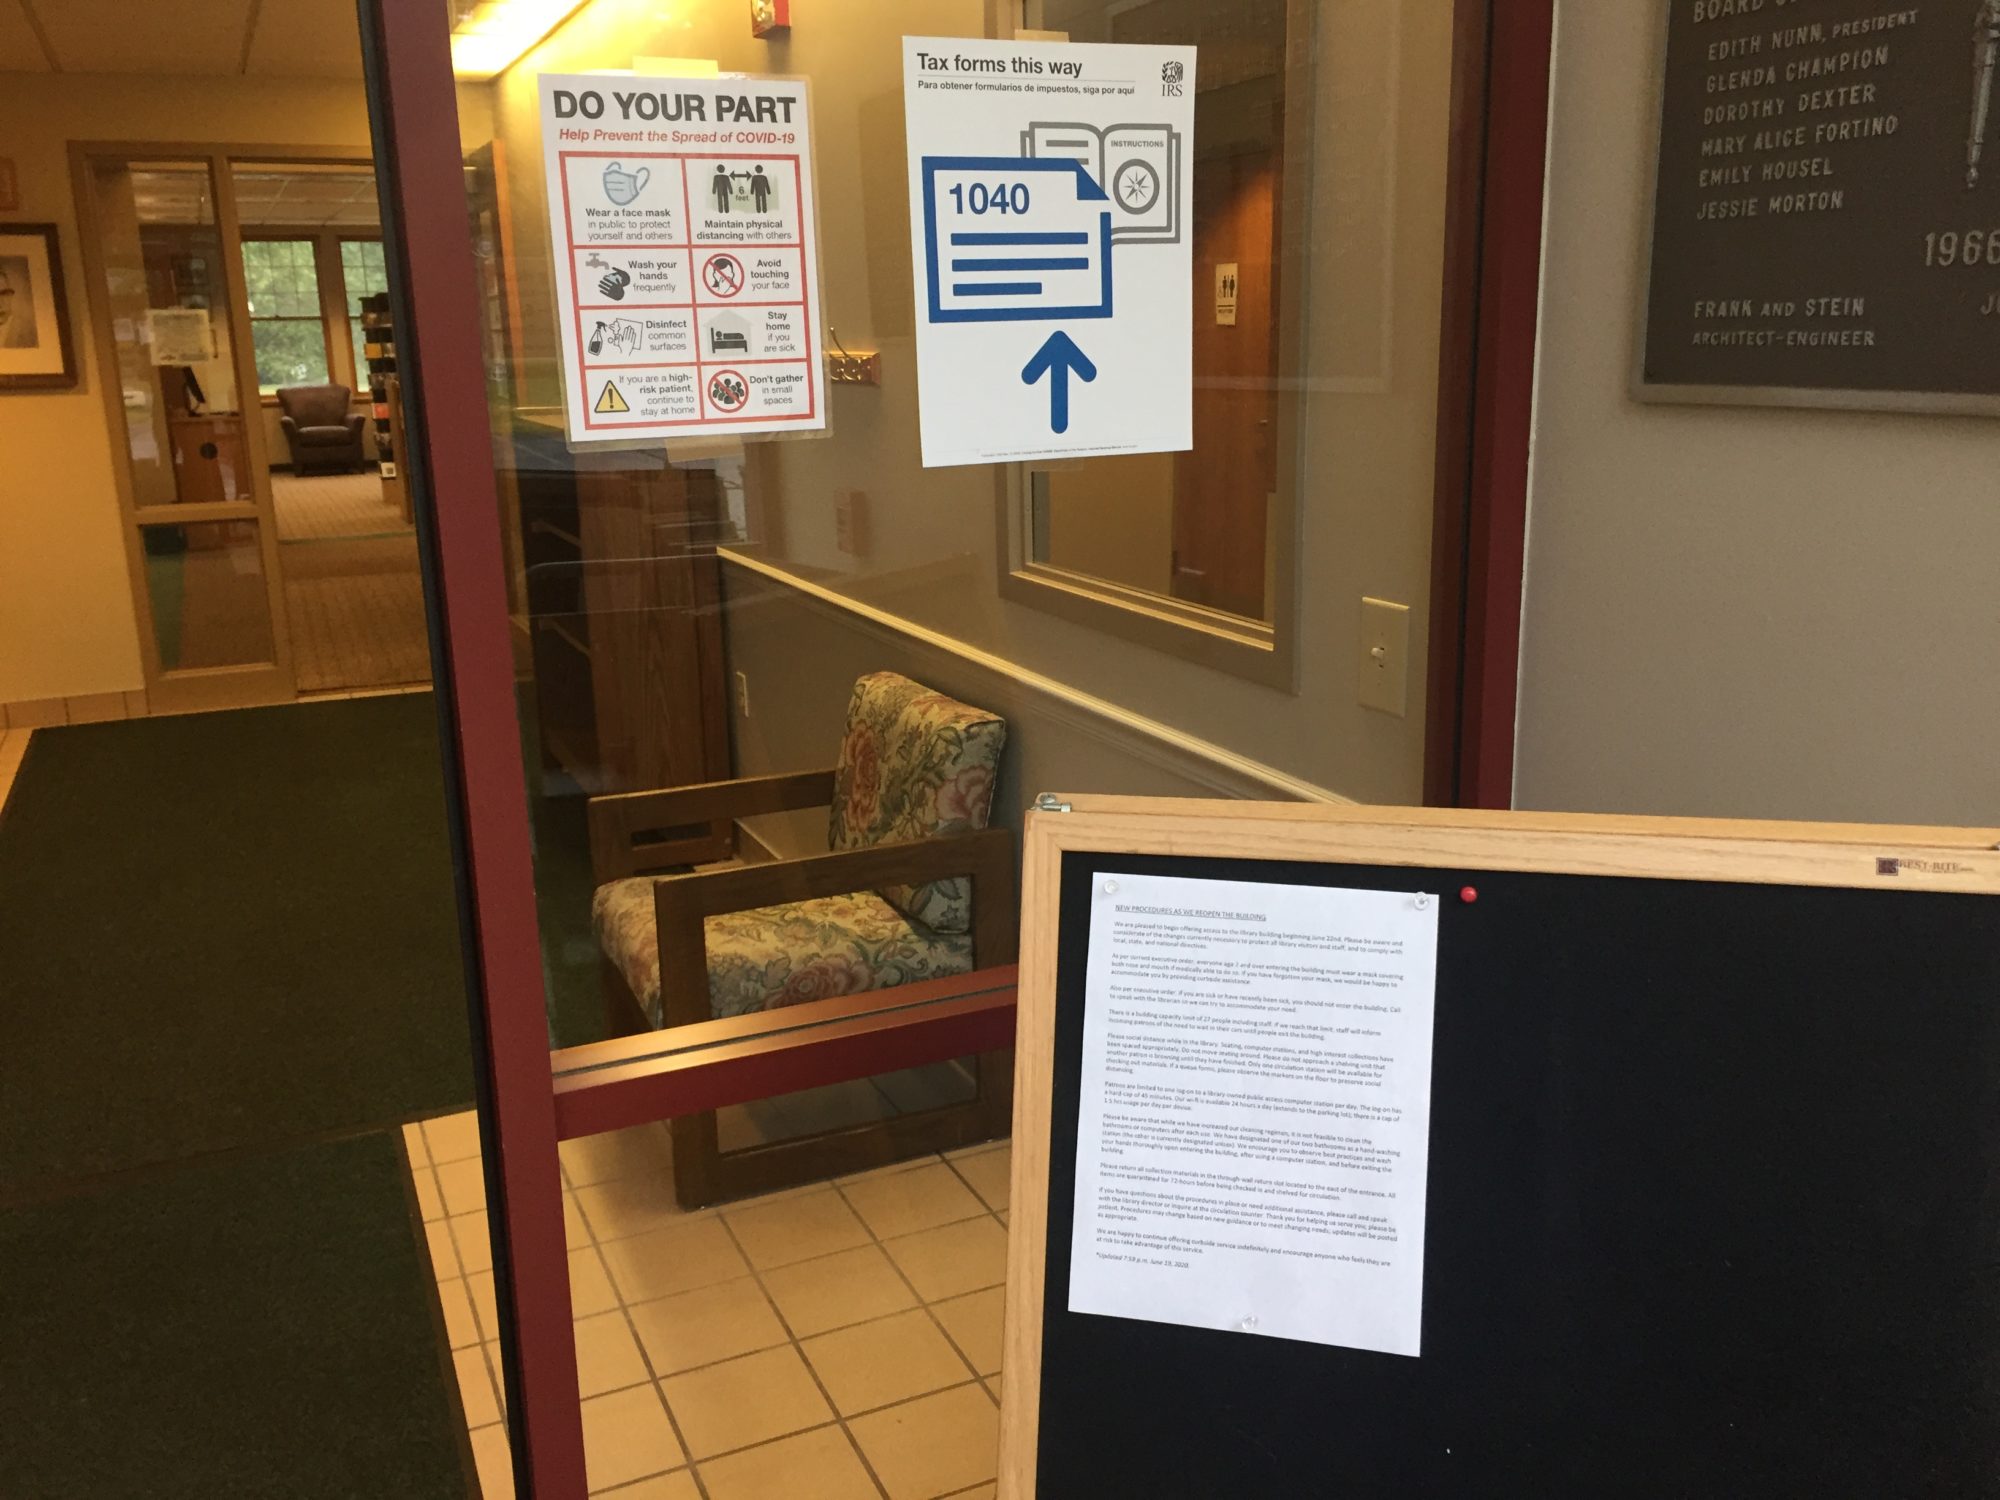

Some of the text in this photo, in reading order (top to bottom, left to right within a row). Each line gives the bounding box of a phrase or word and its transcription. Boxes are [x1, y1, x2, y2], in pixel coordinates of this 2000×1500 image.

[1694, 0, 1763, 23] BOARD
[1708, 10, 1919, 61] EDITH NUNN, PRESIDENT
[917, 53, 1082, 78] Tax forms this way
[1707, 46, 1889, 93] GLENDA CHAMPION
[918, 81, 937, 89] Para
[940, 81, 972, 90] obtener
[975, 83, 1022, 92] formularios
[1024, 84, 1034, 93] de
[1037, 84, 1081, 95] impuestos,
[1083, 86, 1100, 96] siga
[1162, 84, 1182, 97] IRS
[553, 90, 796, 124] DO YOUR PART
[1704, 84, 1877, 125] DOROTHY DEXTER
[559, 128, 795, 144] Help Prevent the Spread of COVID-19
[1702, 115, 1898, 156] MARY ALICE FORTINO
[1699, 158, 1833, 187] EMILY HOUSEL
[738, 186, 745, 196] 6
[949, 182, 1030, 215] 1040
[1697, 191, 1844, 220] JESSIE MORTON
[586, 209, 610, 217] Wear
[622, 209, 643, 217] face
[645, 209, 670, 217] mask
[599, 220, 627, 230] public
[640, 221, 670, 230] protect
[705, 220, 783, 230] Maintain physical
[588, 232, 623, 241] yourself
[697, 232, 744, 241] distancing
[657, 261, 677, 270] your
[751, 270, 789, 279] touching
[633, 283, 676, 293] frequently
[1694, 298, 1864, 318] FRANK AND STEIN
[768, 312, 787, 321] Stay
[766, 322, 790, 330] home
[1692, 331, 1874, 346] ARCHITECT-ENGINEER
[650, 342, 686, 351] surfaces
[627, 376, 642, 385] you
[669, 374, 694, 383] high-
[750, 375, 804, 384] Don't gather
[640, 385, 656, 393] risk
[647, 395, 696, 404] continue to
[764, 397, 792, 405] spaces
[641, 406, 697, 417] stay at home
